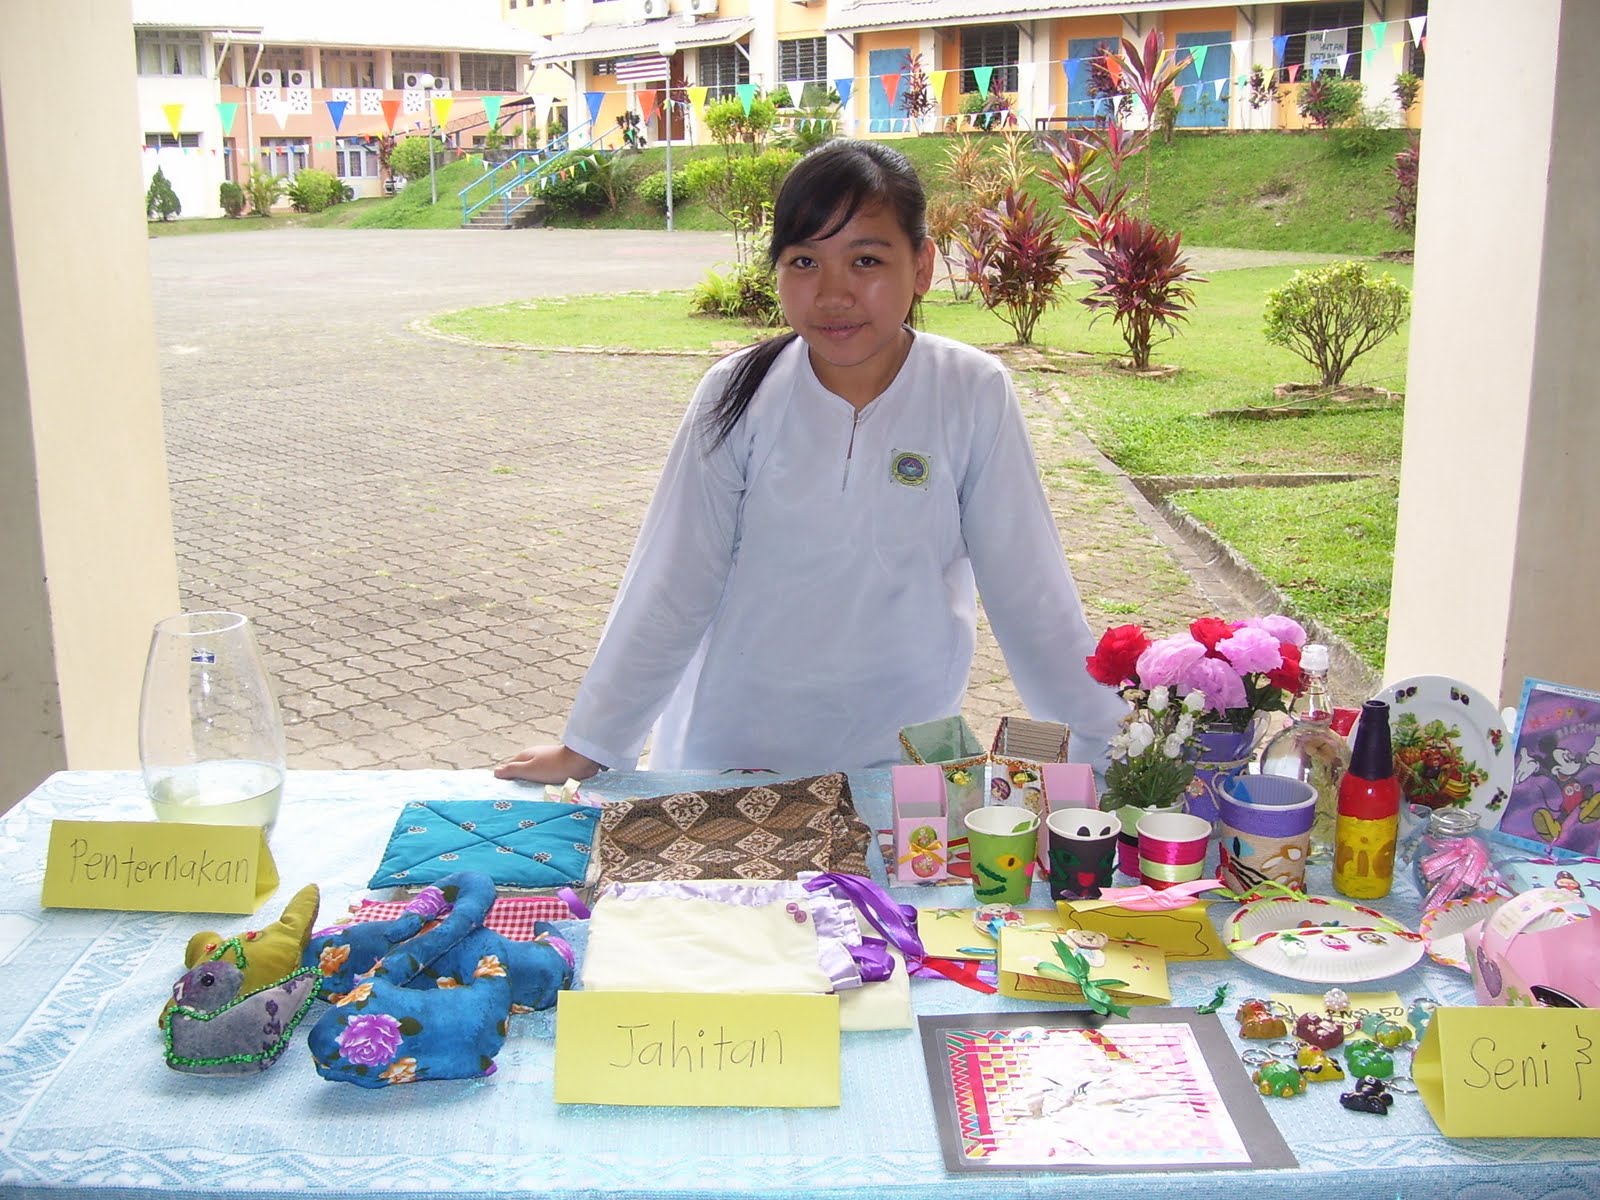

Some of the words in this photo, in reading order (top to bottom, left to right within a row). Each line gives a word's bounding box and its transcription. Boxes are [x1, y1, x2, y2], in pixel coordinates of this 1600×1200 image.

[70, 838, 249, 888] Penternakan
[610, 1020, 782, 1072] Jahitan
[1464, 1037, 1549, 1090] Seni
